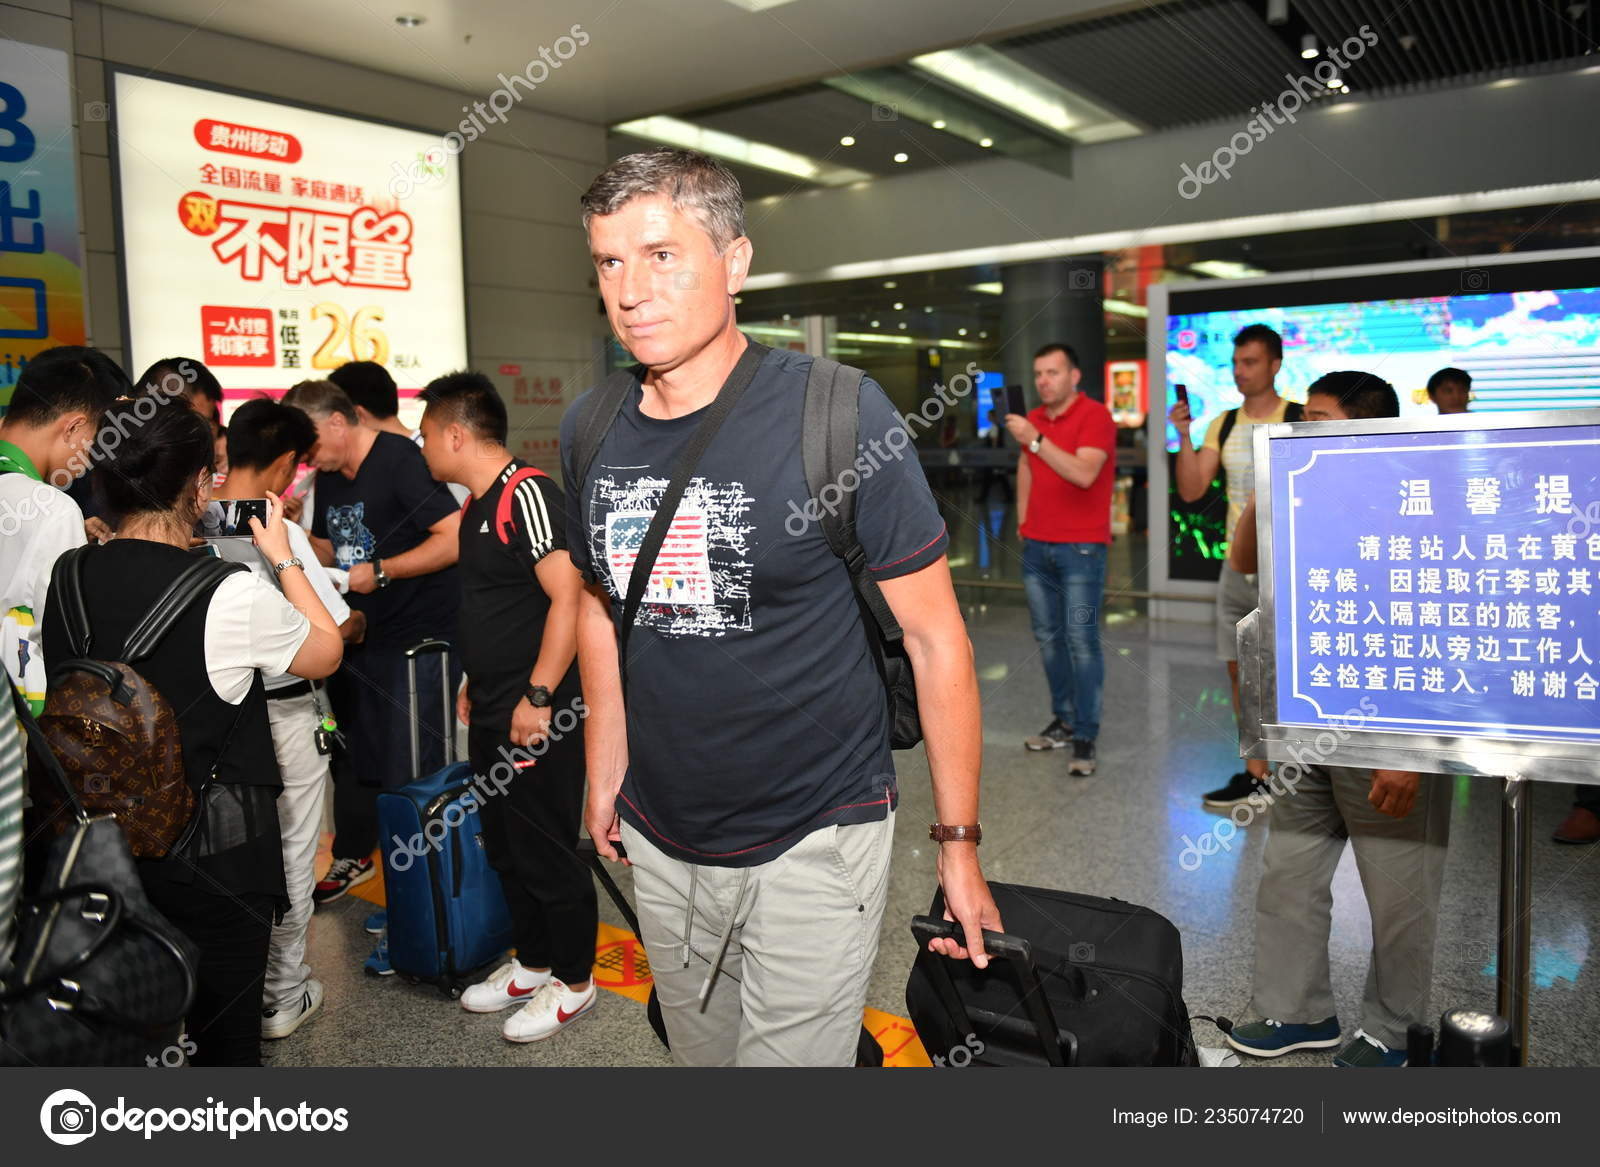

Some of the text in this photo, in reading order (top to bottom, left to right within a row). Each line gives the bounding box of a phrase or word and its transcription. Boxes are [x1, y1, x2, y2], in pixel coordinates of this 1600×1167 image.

[210, 125, 288, 157] 贵州移动
[199, 163, 281, 194] 全国流量
[310, 301, 389, 370] 26
[1399, 475, 1572, 516] 温馨提
[1307, 567, 1600, 596] 等候，因提取行李或其
[1308, 599, 1600, 631] 次进入隔离区的旅客，
[1309, 632, 1600, 665] 乘机凭证从旁边工作人
